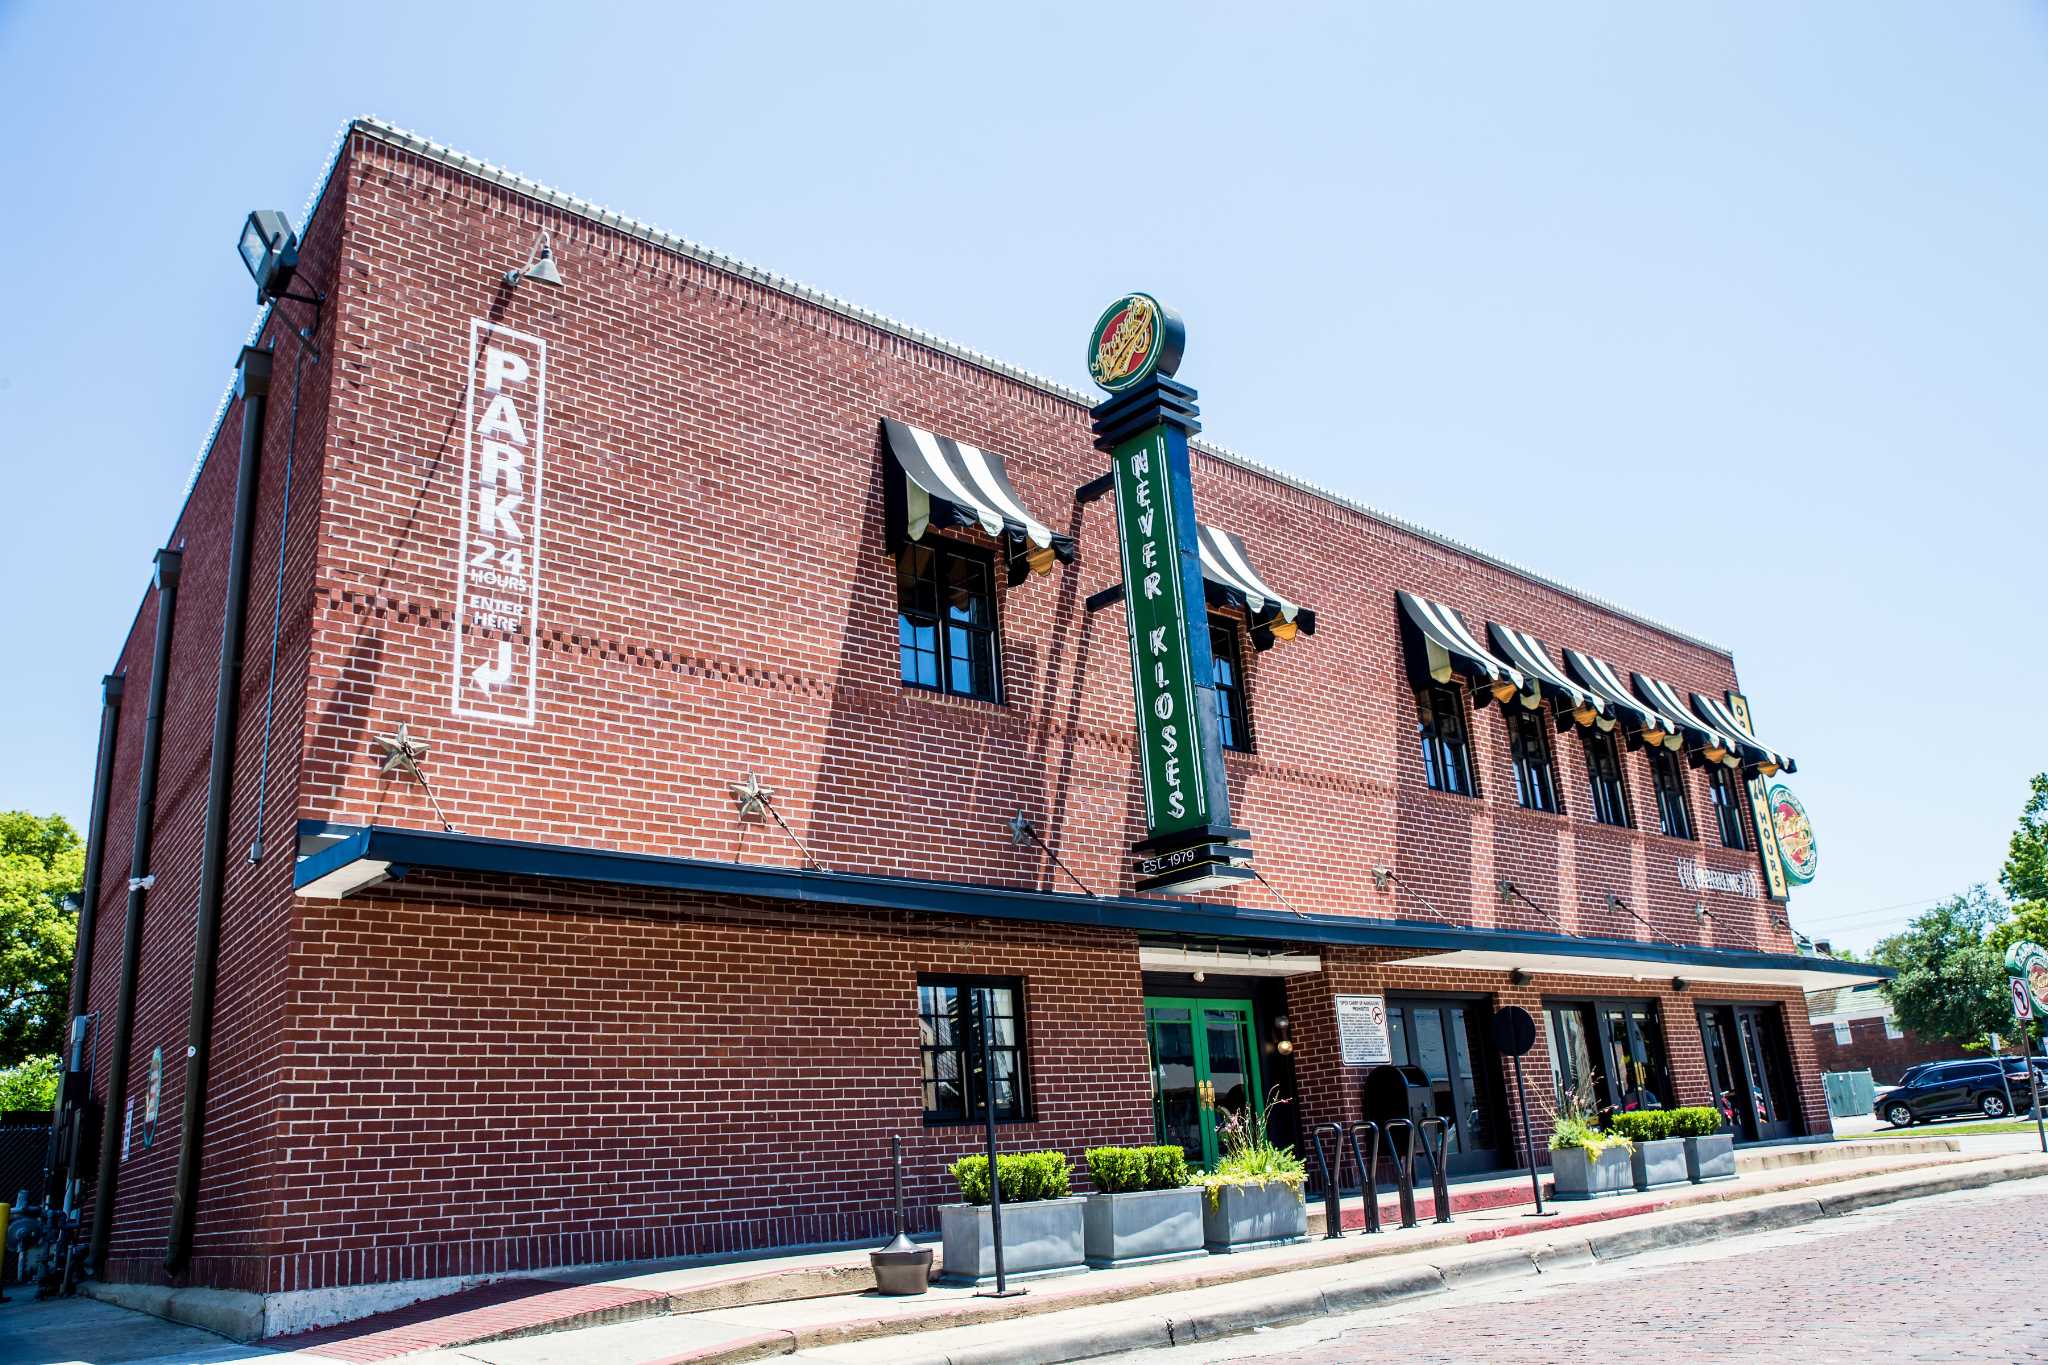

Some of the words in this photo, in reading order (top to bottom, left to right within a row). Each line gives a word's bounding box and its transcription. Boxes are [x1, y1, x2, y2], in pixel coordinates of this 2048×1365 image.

[475, 346, 530, 540] PARK
[470, 540, 526, 576] 24
[470, 568, 528, 592] HOURS
[470, 595, 524, 615] ENTER
[473, 611, 519, 634] HERE
[1130, 448, 1163, 600] NEVER
[1149, 625, 1185, 819] KLOSES
[1167, 849, 1195, 867] 1979
[1759, 811, 1781, 888] HOURS
